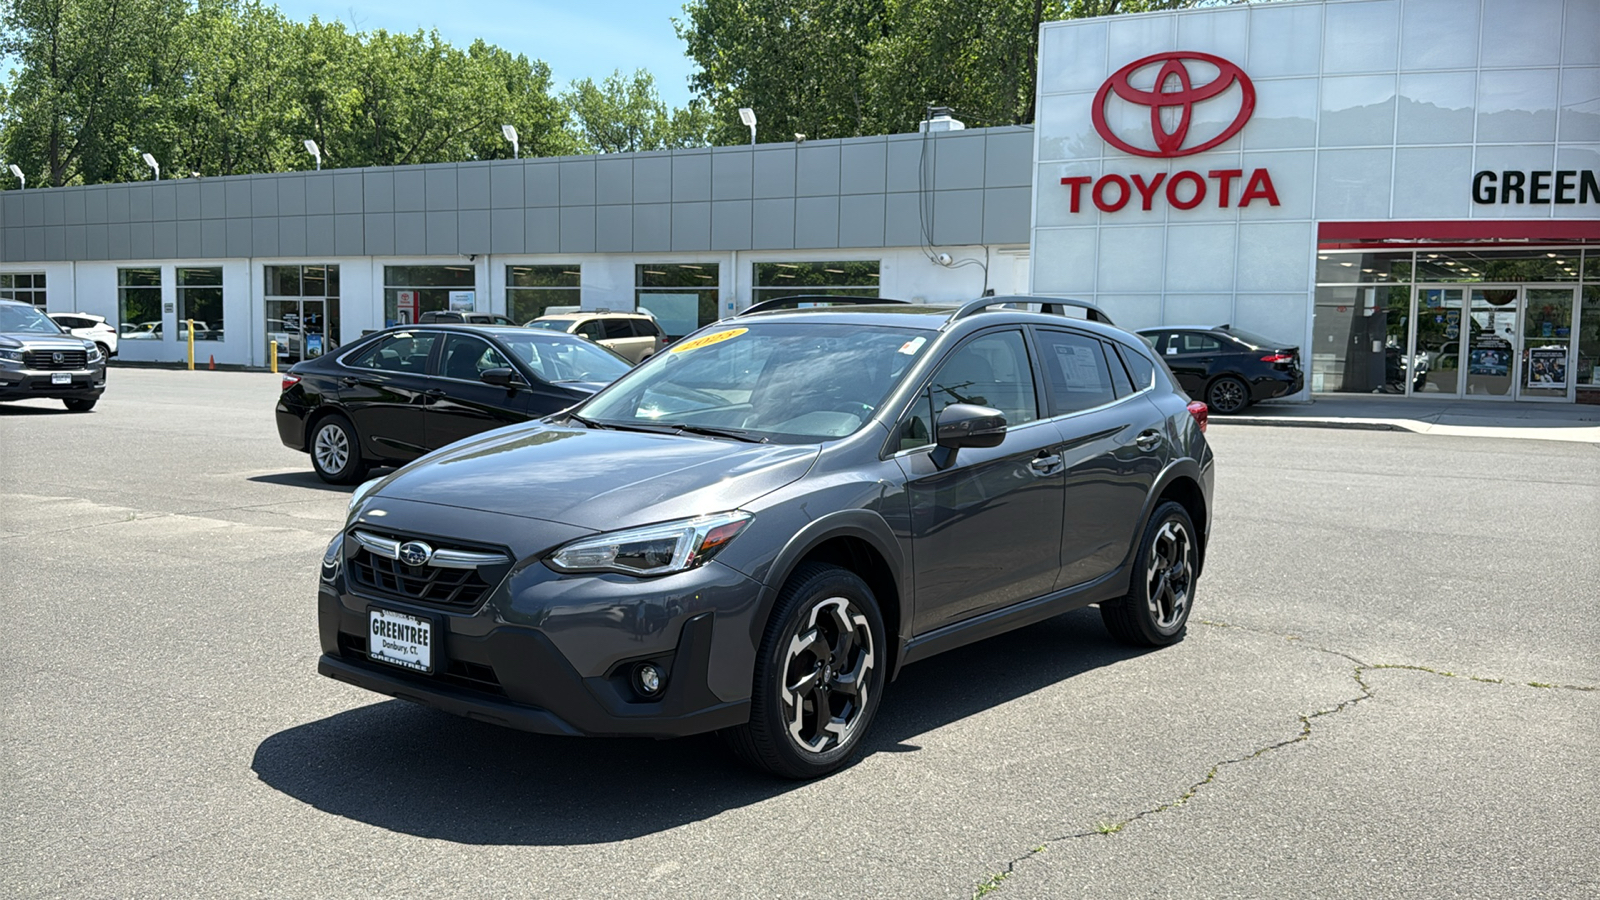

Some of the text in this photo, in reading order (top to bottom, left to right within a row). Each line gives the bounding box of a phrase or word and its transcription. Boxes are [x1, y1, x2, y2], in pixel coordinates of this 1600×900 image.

[1060, 168, 1281, 213] TOYOTA
[1472, 170, 1600, 205] GREEN
[372, 618, 428, 647] GREENTREE
[382, 639, 408, 655] Danbury,
